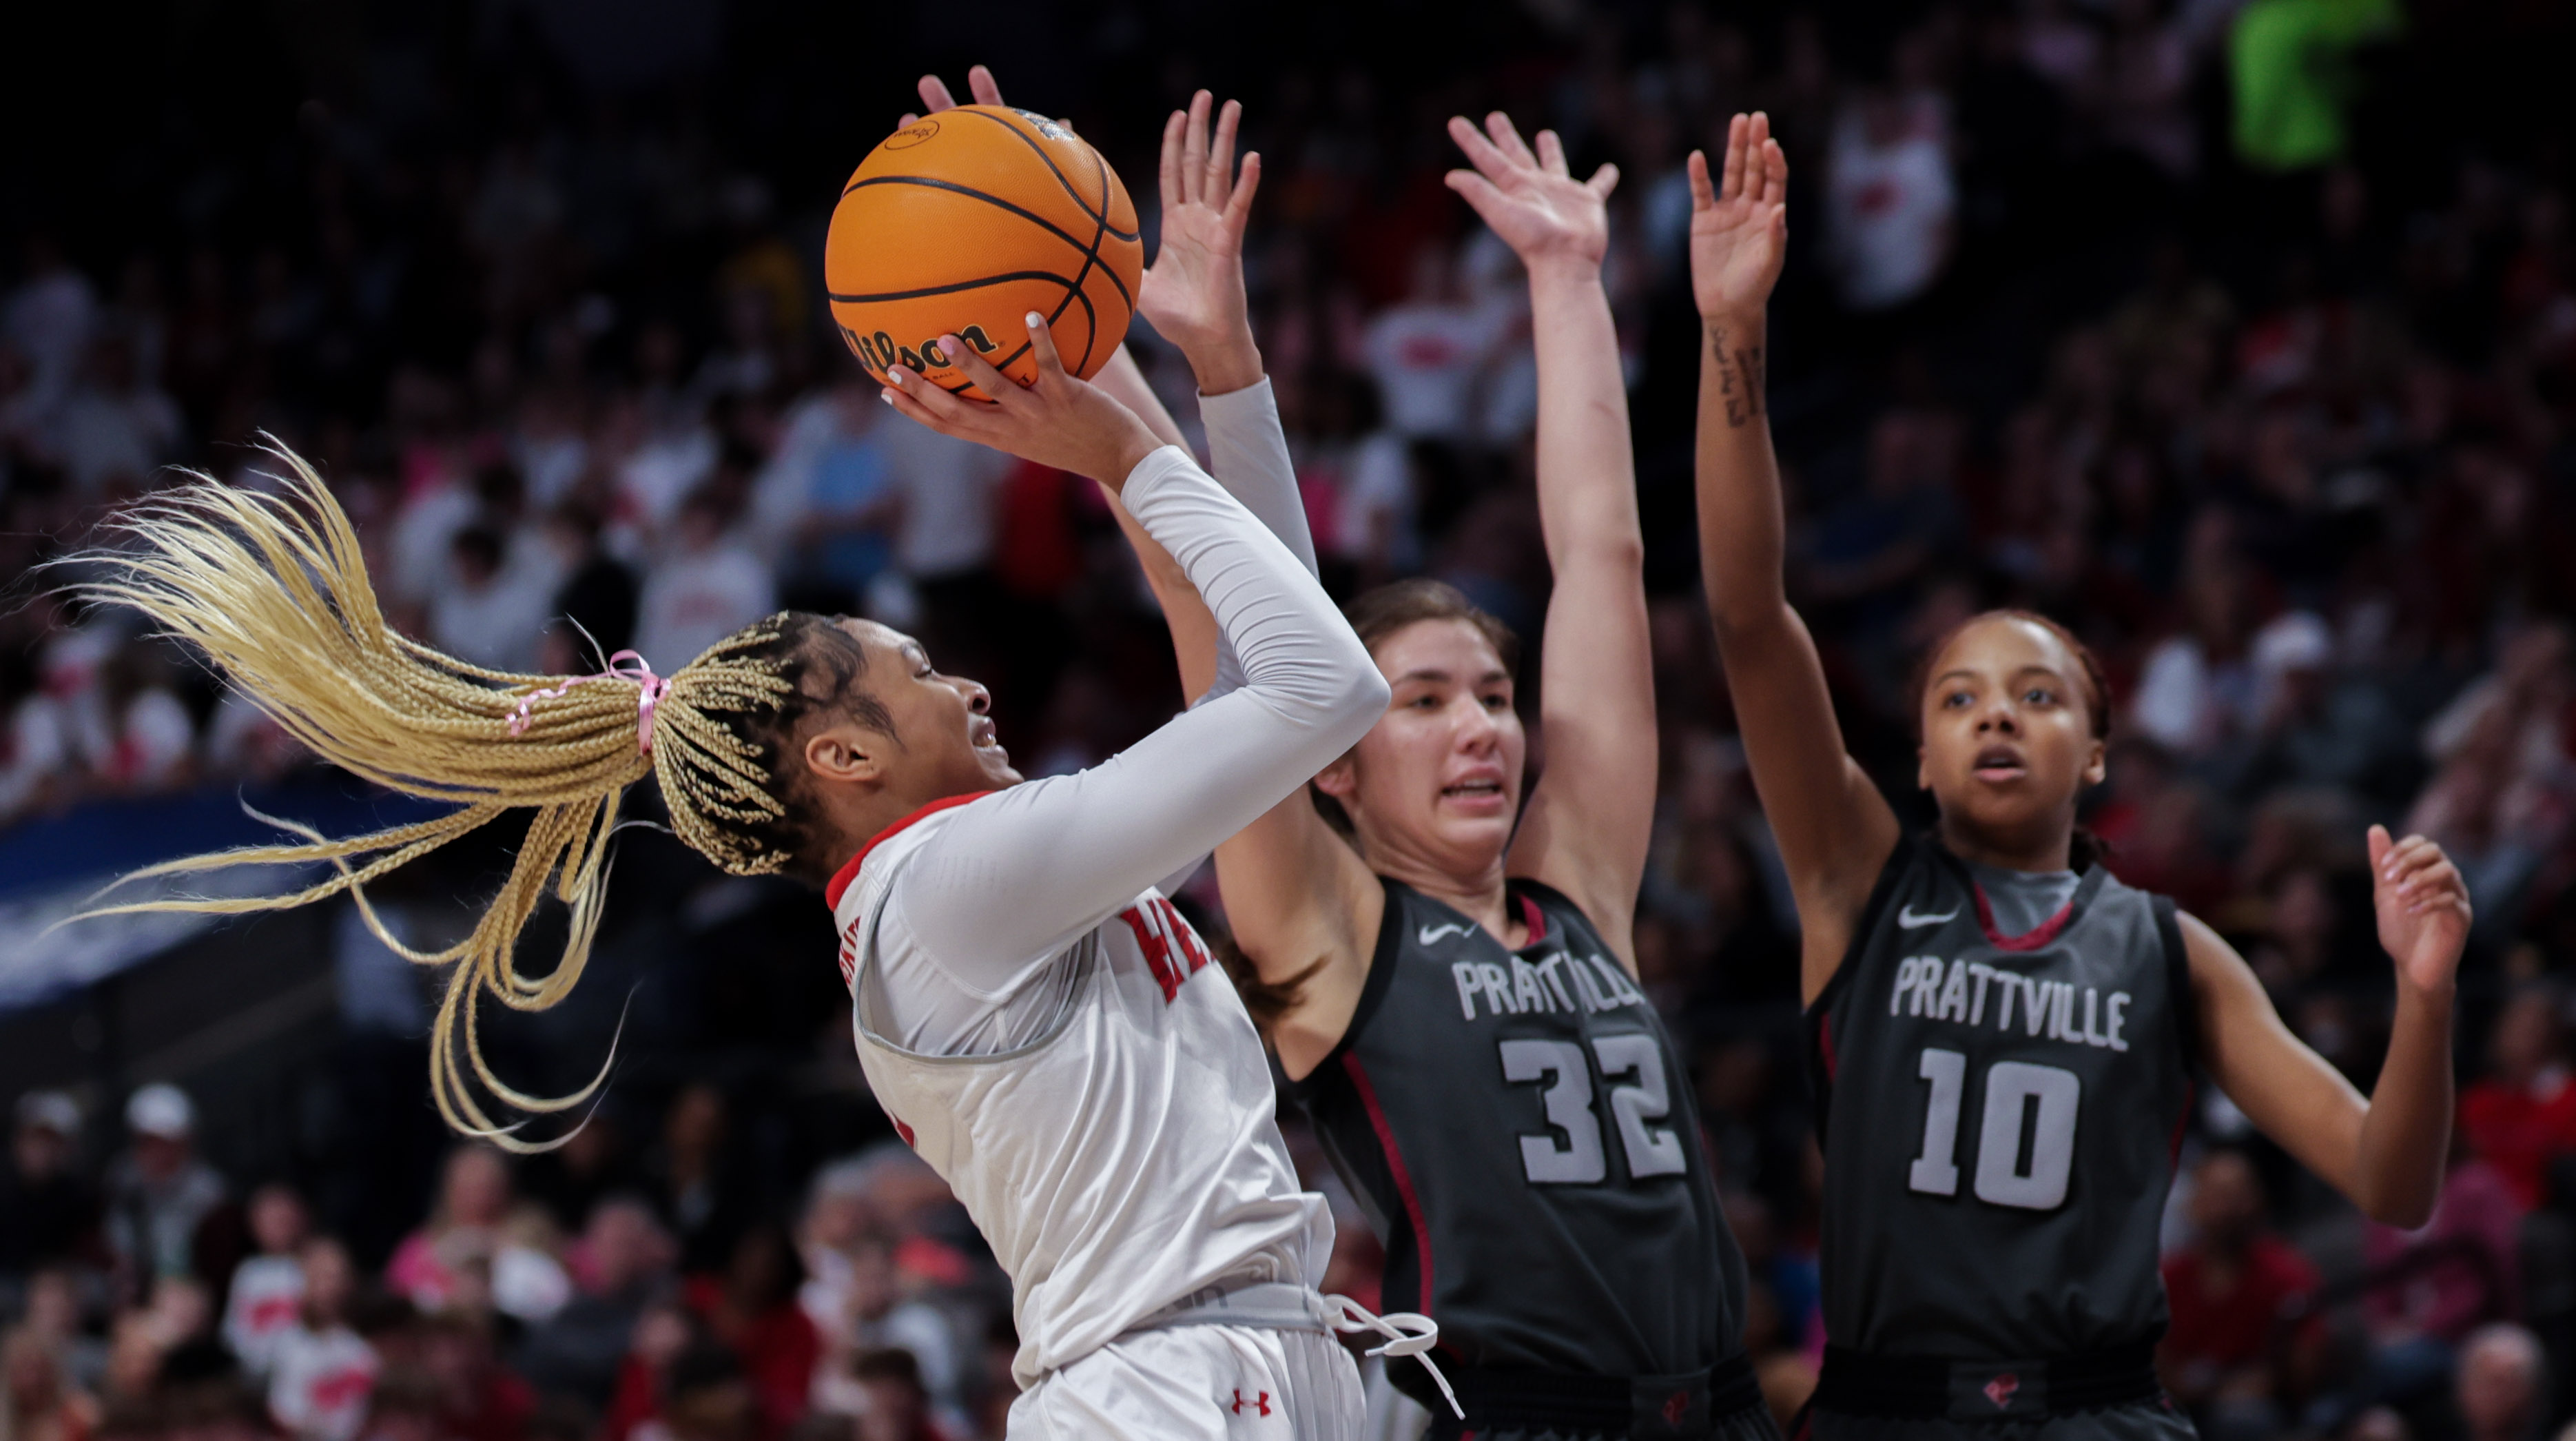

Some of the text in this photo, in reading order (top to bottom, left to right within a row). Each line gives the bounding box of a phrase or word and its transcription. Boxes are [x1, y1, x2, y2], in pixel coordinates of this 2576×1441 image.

[1890, 954, 2132, 1052] PRATTVILLE
[1498, 1035, 1687, 1183] 32
[1908, 1047, 2081, 1212] 10
